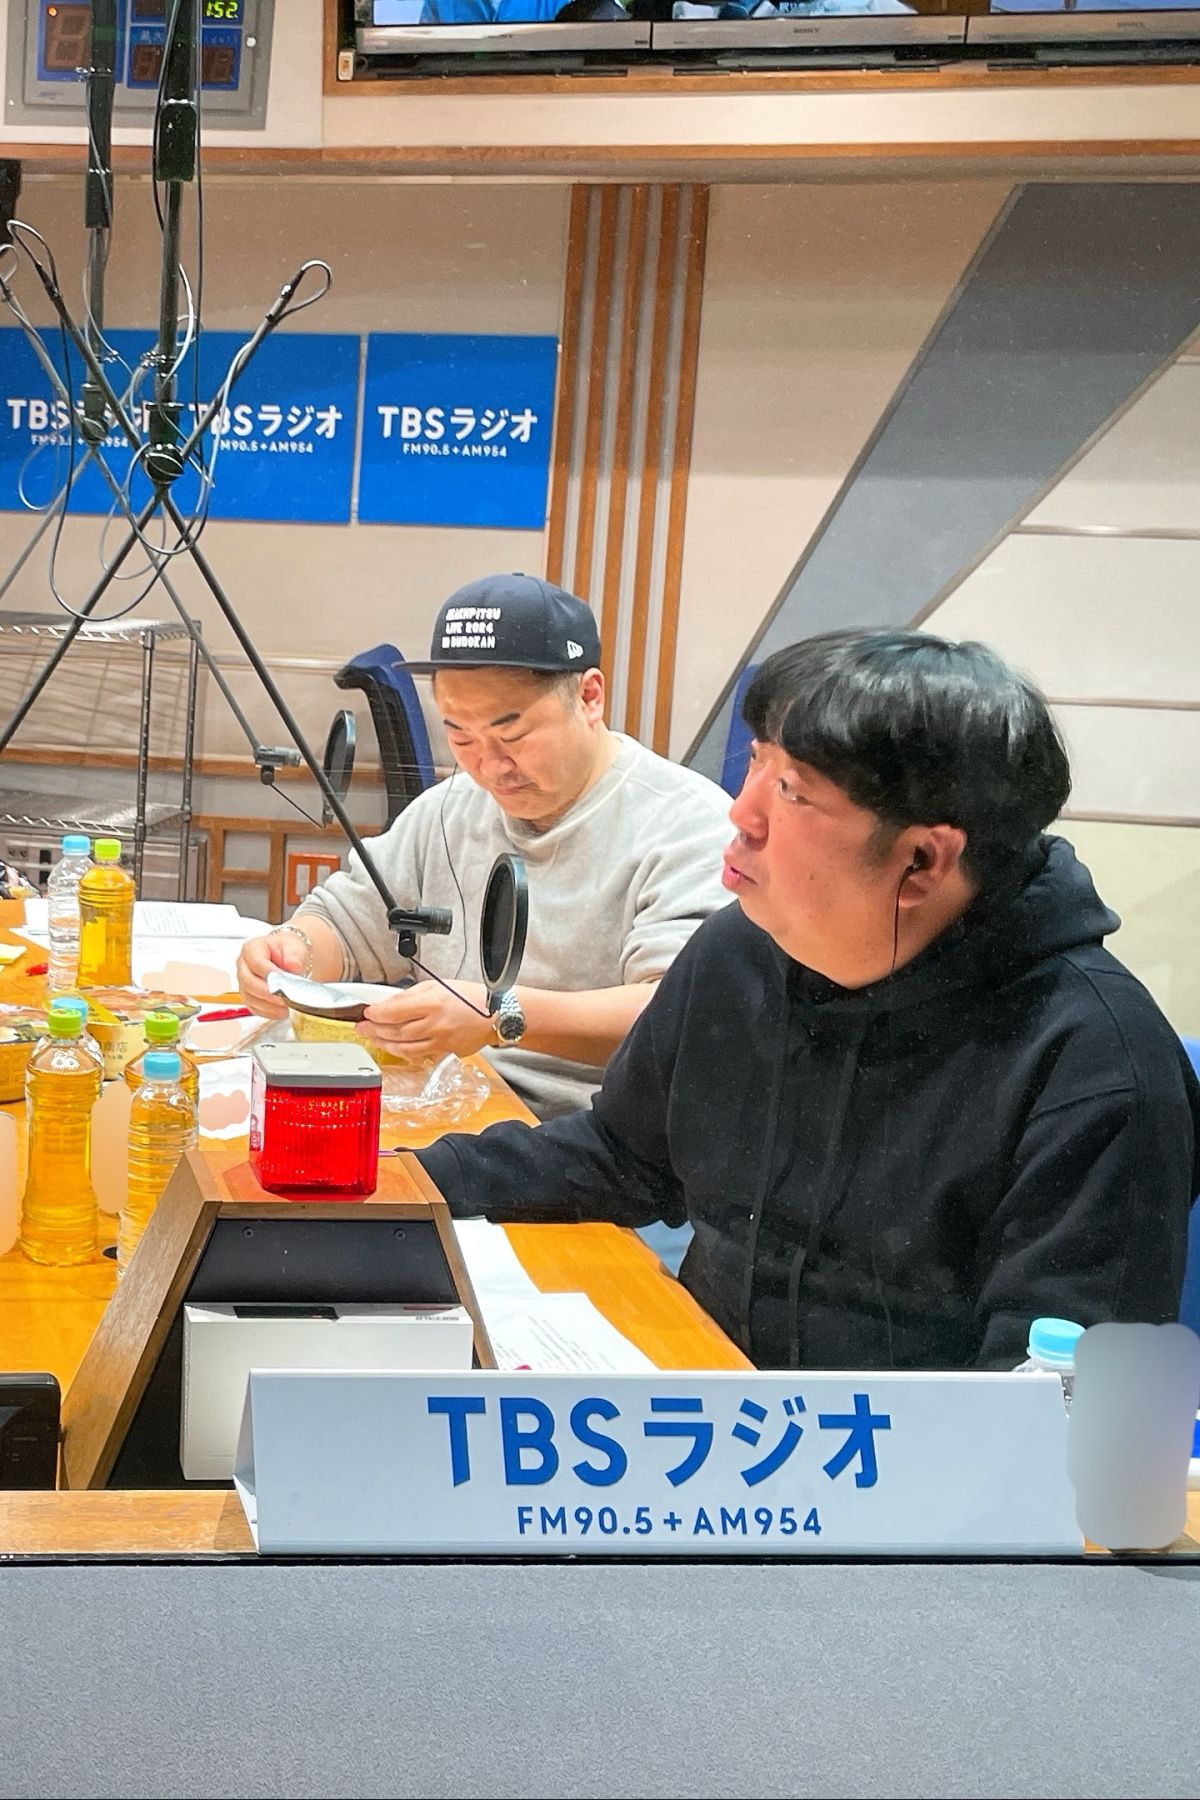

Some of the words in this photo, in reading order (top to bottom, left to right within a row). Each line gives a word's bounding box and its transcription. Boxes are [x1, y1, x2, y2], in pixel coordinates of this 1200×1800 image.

[377, 405, 538, 443] TBSラジオ
[213, 439, 314, 454] M90.5+AM954
[427, 1392, 893, 1488] TBSラジオ
